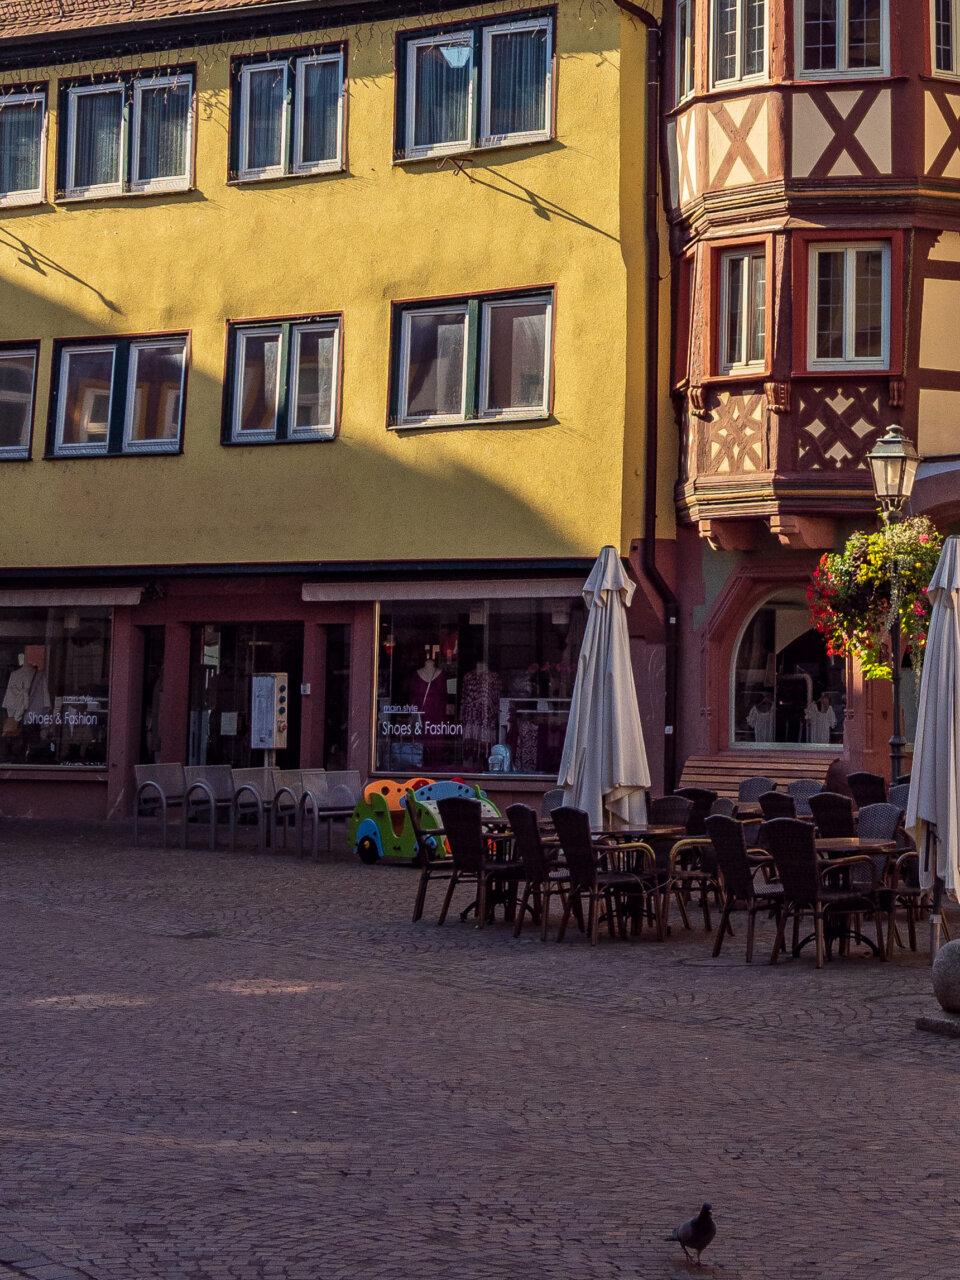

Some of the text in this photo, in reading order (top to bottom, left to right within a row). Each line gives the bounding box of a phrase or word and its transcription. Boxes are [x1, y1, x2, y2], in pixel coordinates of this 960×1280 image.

[27, 711, 98, 725] Shoes & Fashion
[382, 721, 463, 735] Shoes & Fashion
